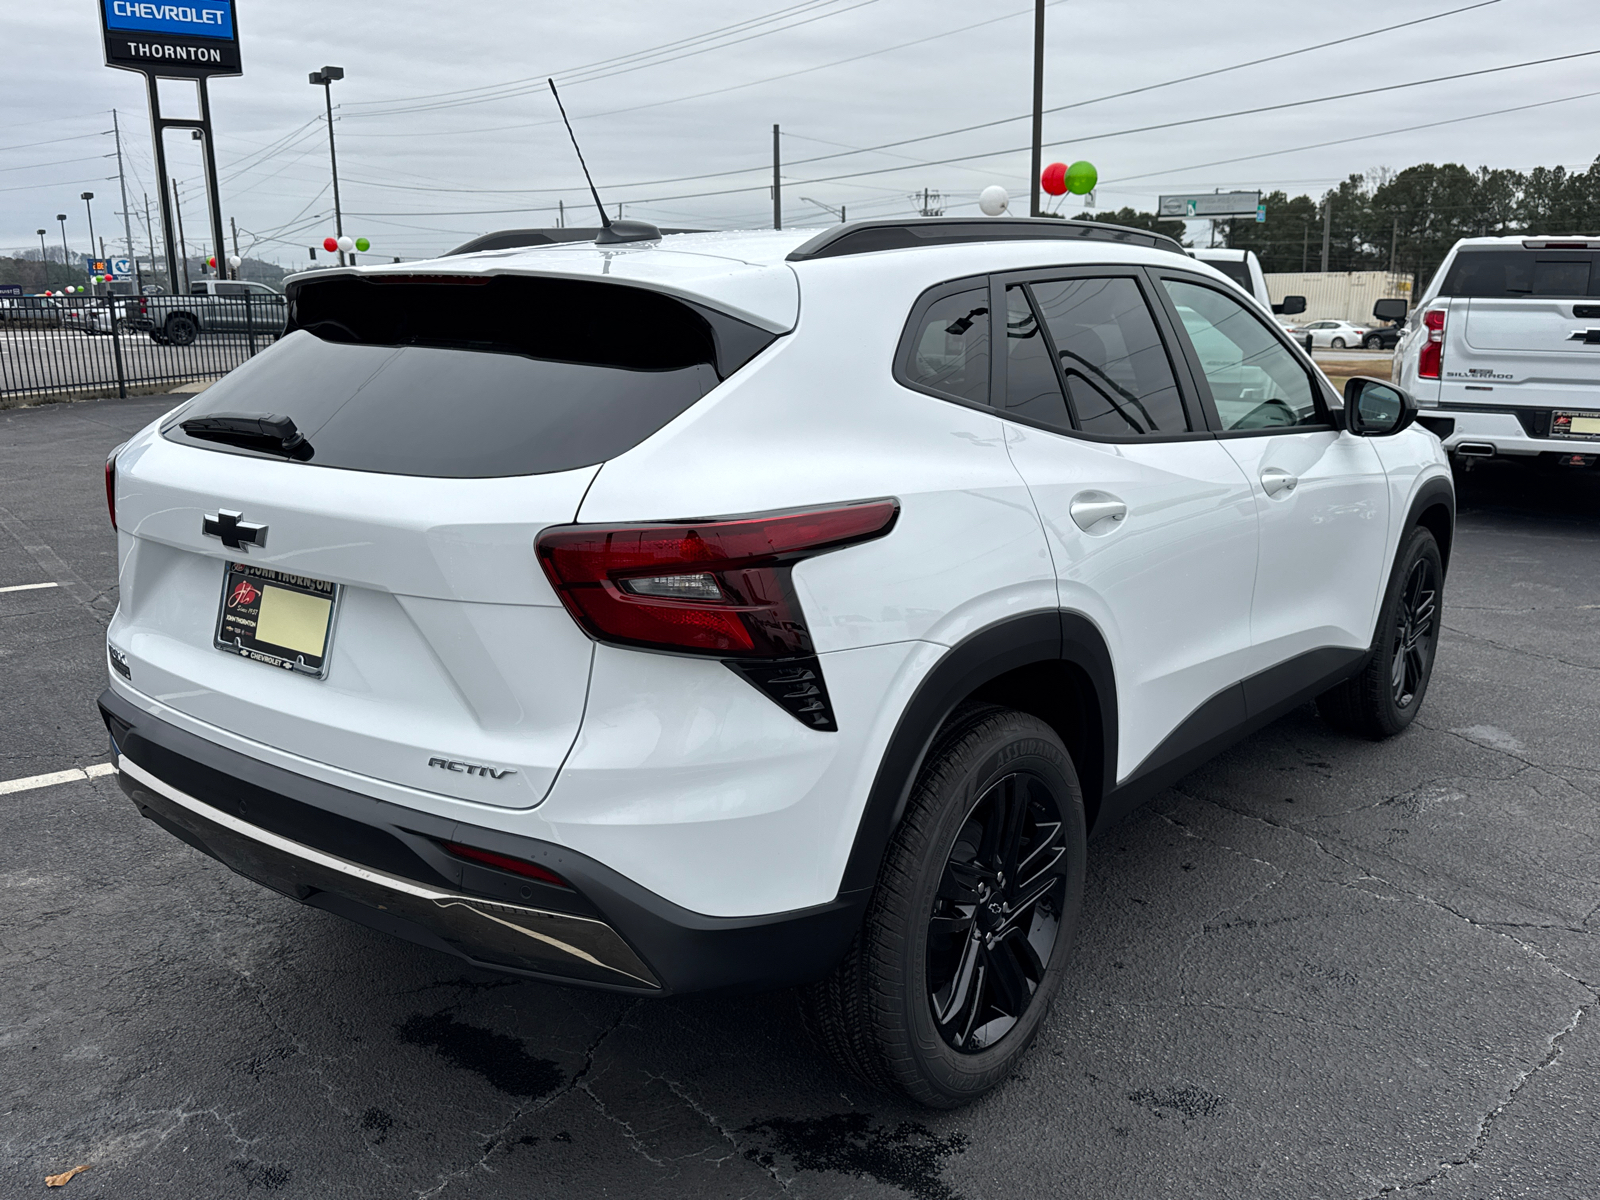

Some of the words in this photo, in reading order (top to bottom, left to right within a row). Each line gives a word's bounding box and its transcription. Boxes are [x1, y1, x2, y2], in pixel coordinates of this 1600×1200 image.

[113, 1, 225, 25] CHEVROLET
[127, 42, 221, 63] THORNTON
[1446, 372, 1514, 380] SILVERADO
[250, 651, 282, 667] CHEVROLET
[427, 756, 518, 780] ACTIV
